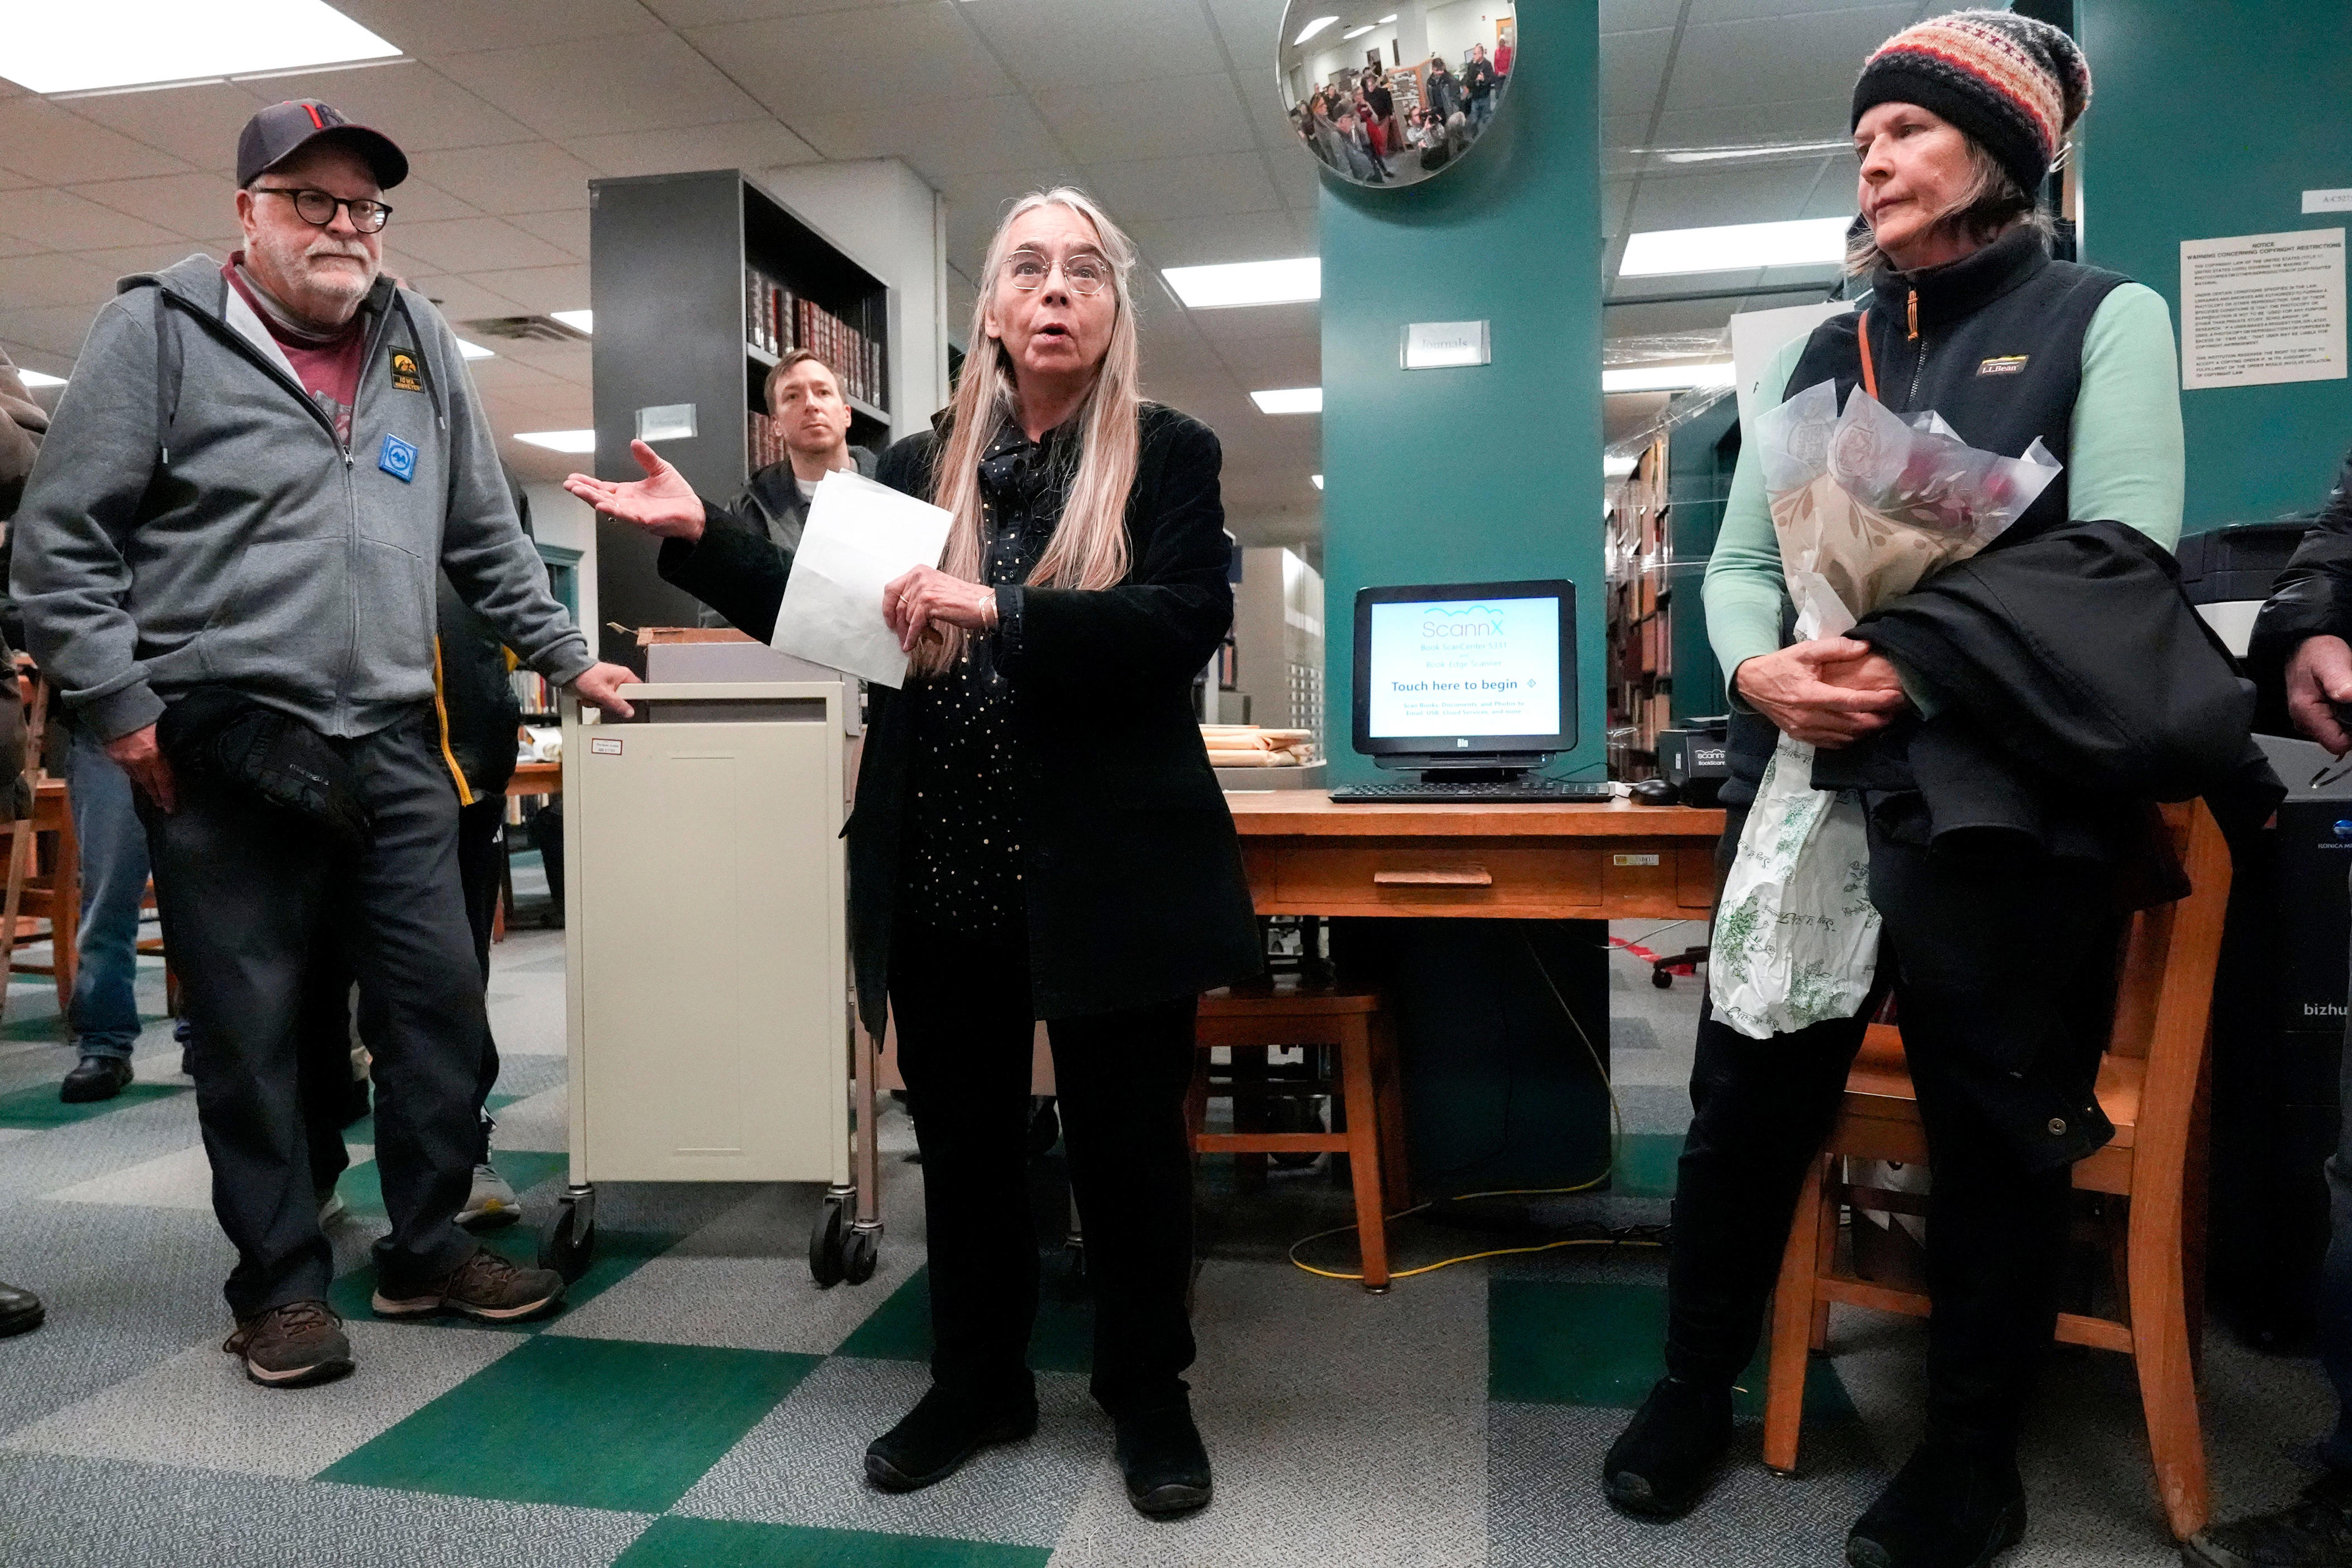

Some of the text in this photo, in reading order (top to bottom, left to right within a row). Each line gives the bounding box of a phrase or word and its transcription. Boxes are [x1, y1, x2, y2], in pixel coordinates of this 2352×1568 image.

[1422, 338, 1468, 350] Journals
[1982, 365, 2017, 374] L.L.Bean
[399, 376, 414, 385] IOWA
[1449, 660, 1468, 670] Edge
[1391, 679, 1518, 692] Touch here to begin
